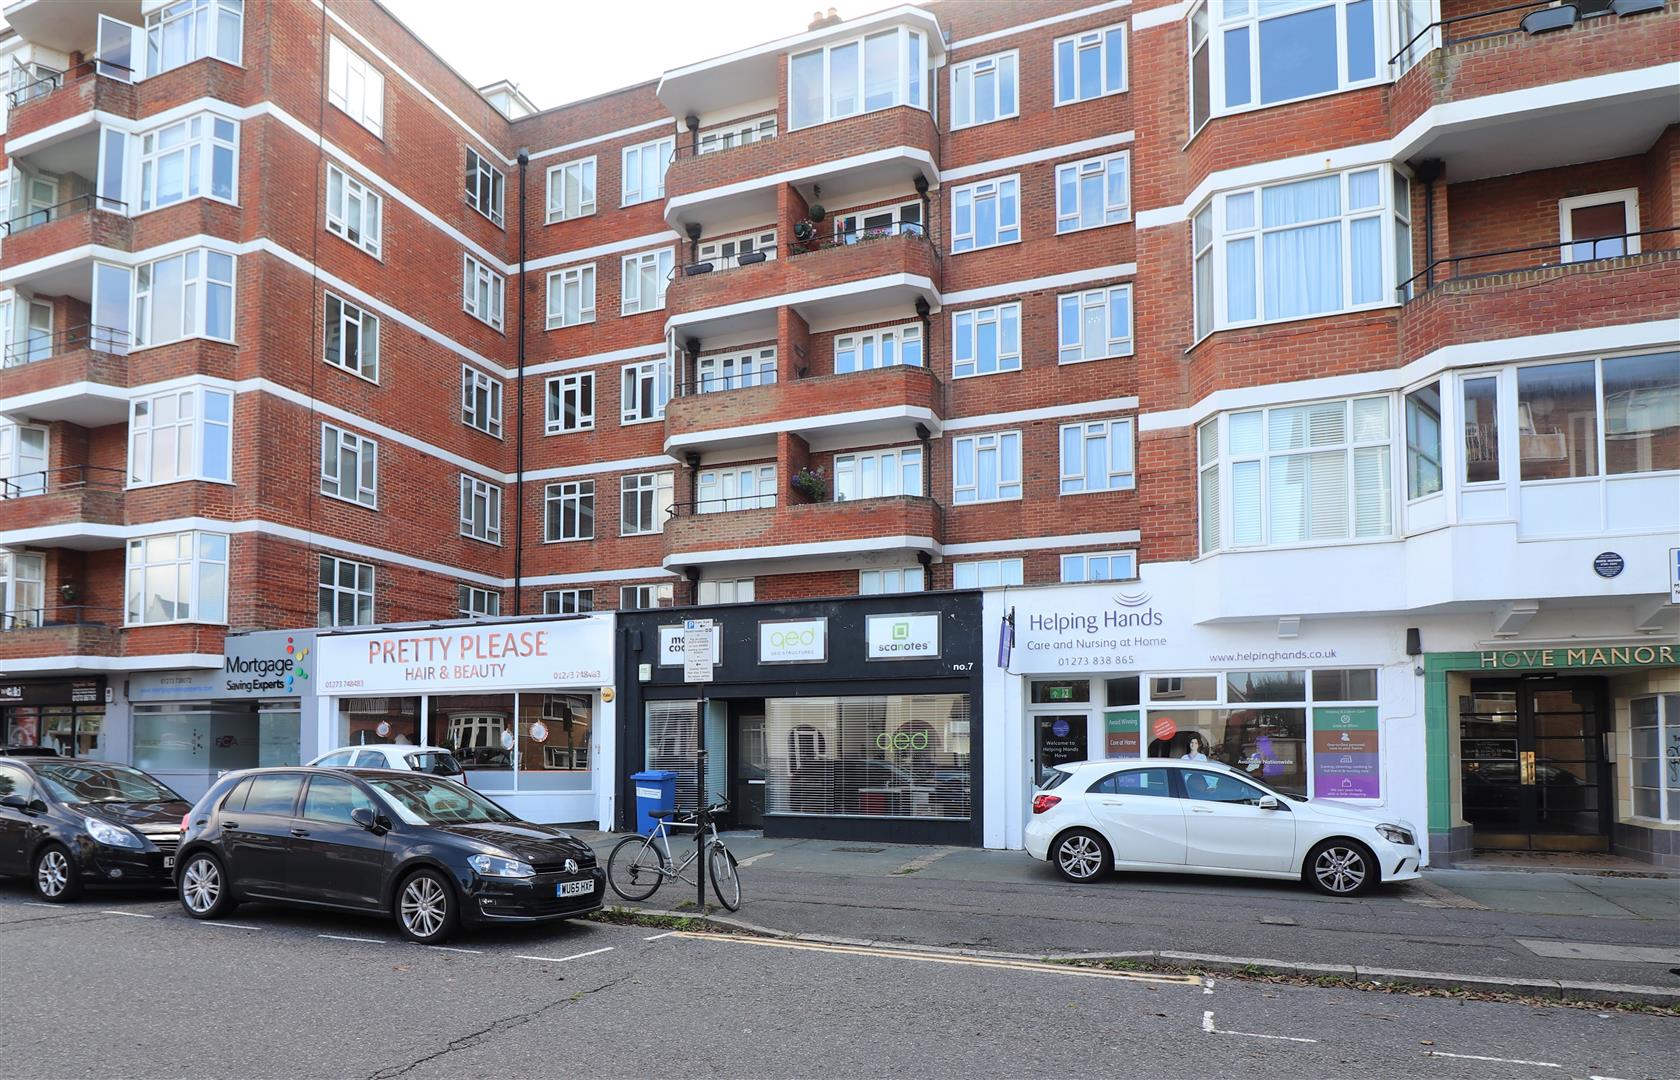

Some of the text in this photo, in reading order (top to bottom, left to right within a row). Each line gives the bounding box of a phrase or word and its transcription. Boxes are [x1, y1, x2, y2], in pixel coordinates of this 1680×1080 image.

[1030, 607, 1163, 634] Helping Hands
[769, 628, 815, 649] qed
[1027, 636, 1167, 651] Care and Nursing at Home
[368, 630, 549, 664] PRETTY PLEASE
[878, 642, 928, 652] scanotes
[1058, 655, 1134, 666] 01273 838 865
[1209, 649, 1337, 662] www.helpinghands.co.uk
[1480, 646, 1675, 668] HOVE MANOR
[226, 655, 293, 677] Mortgage
[405, 663, 506, 681] HAIR & BEAUTY
[953, 662, 974, 671] no.7
[226, 680, 253, 692] Saving
[253, 679, 285, 692] Experts
[876, 729, 928, 753] qed
[561, 882, 580, 895] WU65
